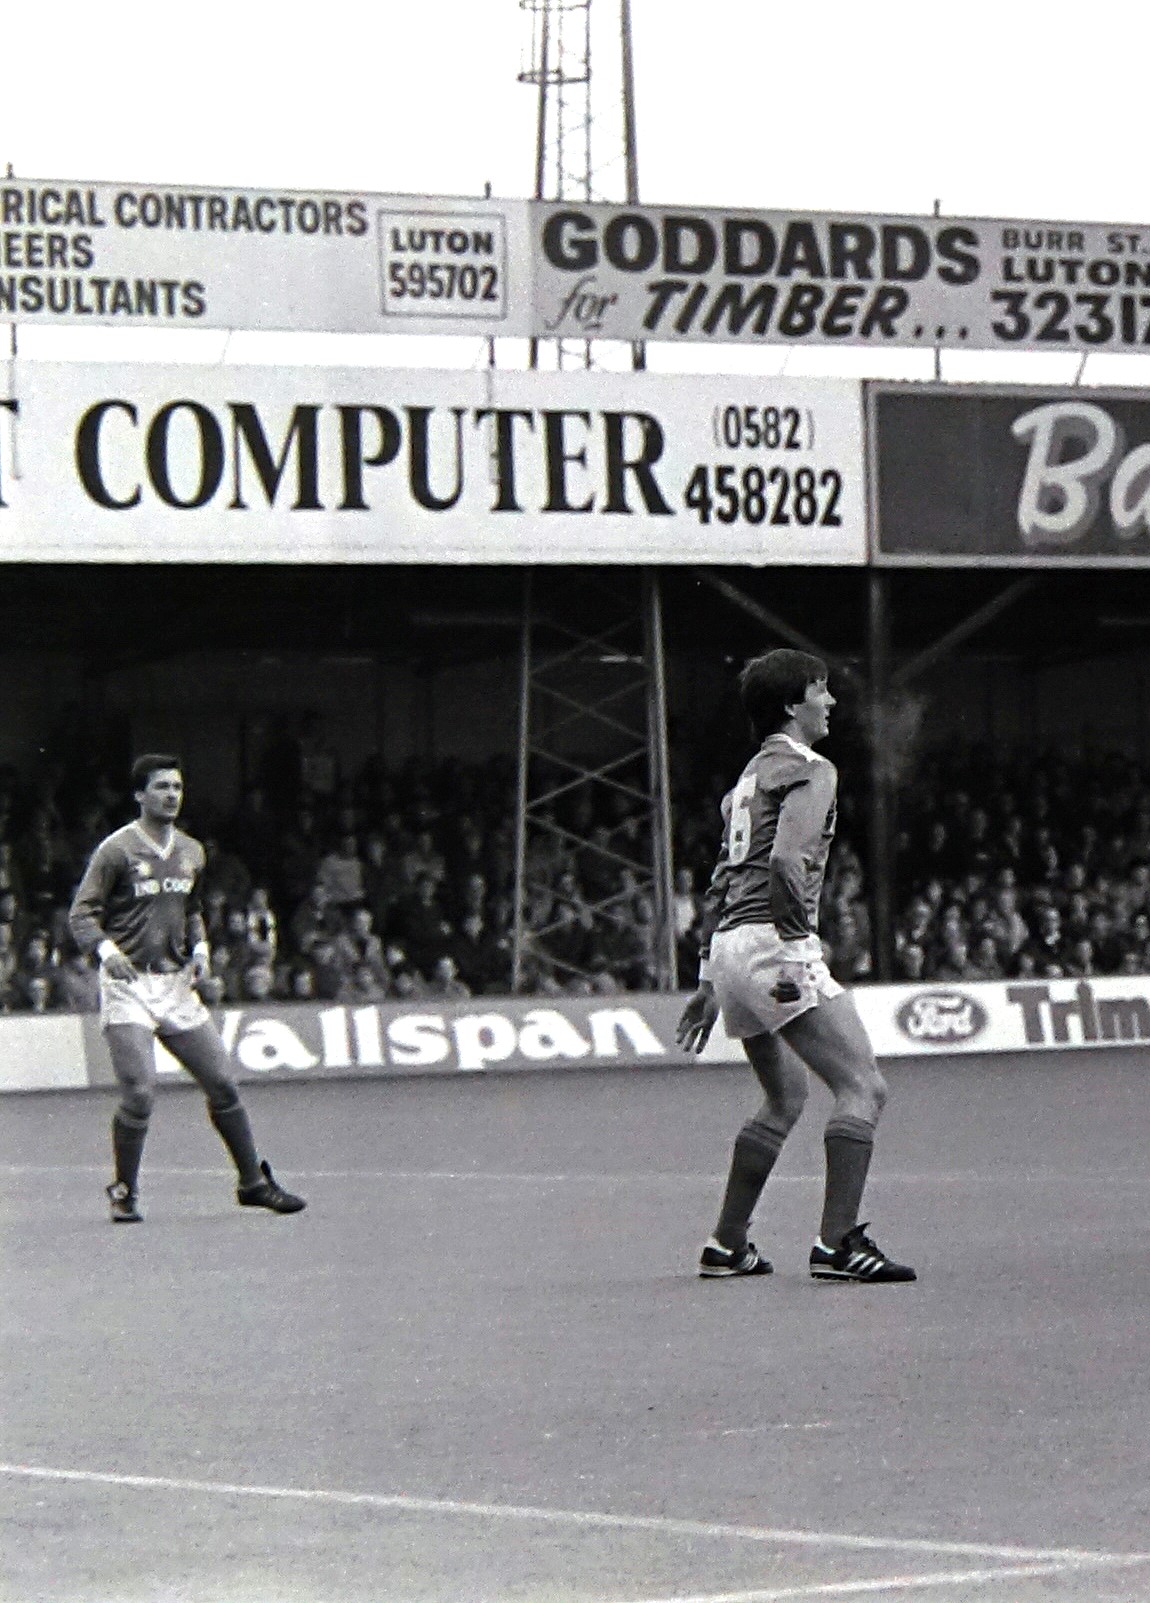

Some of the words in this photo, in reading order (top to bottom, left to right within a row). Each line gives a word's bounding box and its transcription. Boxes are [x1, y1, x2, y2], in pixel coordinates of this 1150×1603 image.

[3, 187, 104, 228] RICAL
[113, 192, 368, 237] CONTRACTORS
[4, 231, 94, 269] EERS
[391, 227, 494, 255] LUTON
[543, 209, 980, 286] GODDARDS
[1002, 227, 1084, 252] BURR
[389, 260, 499, 301] 595702
[545, 274, 618, 331] for
[712, 406, 815, 451] (0582)
[74, 397, 674, 515] COMPUTER
[685, 464, 843, 528] 458282
